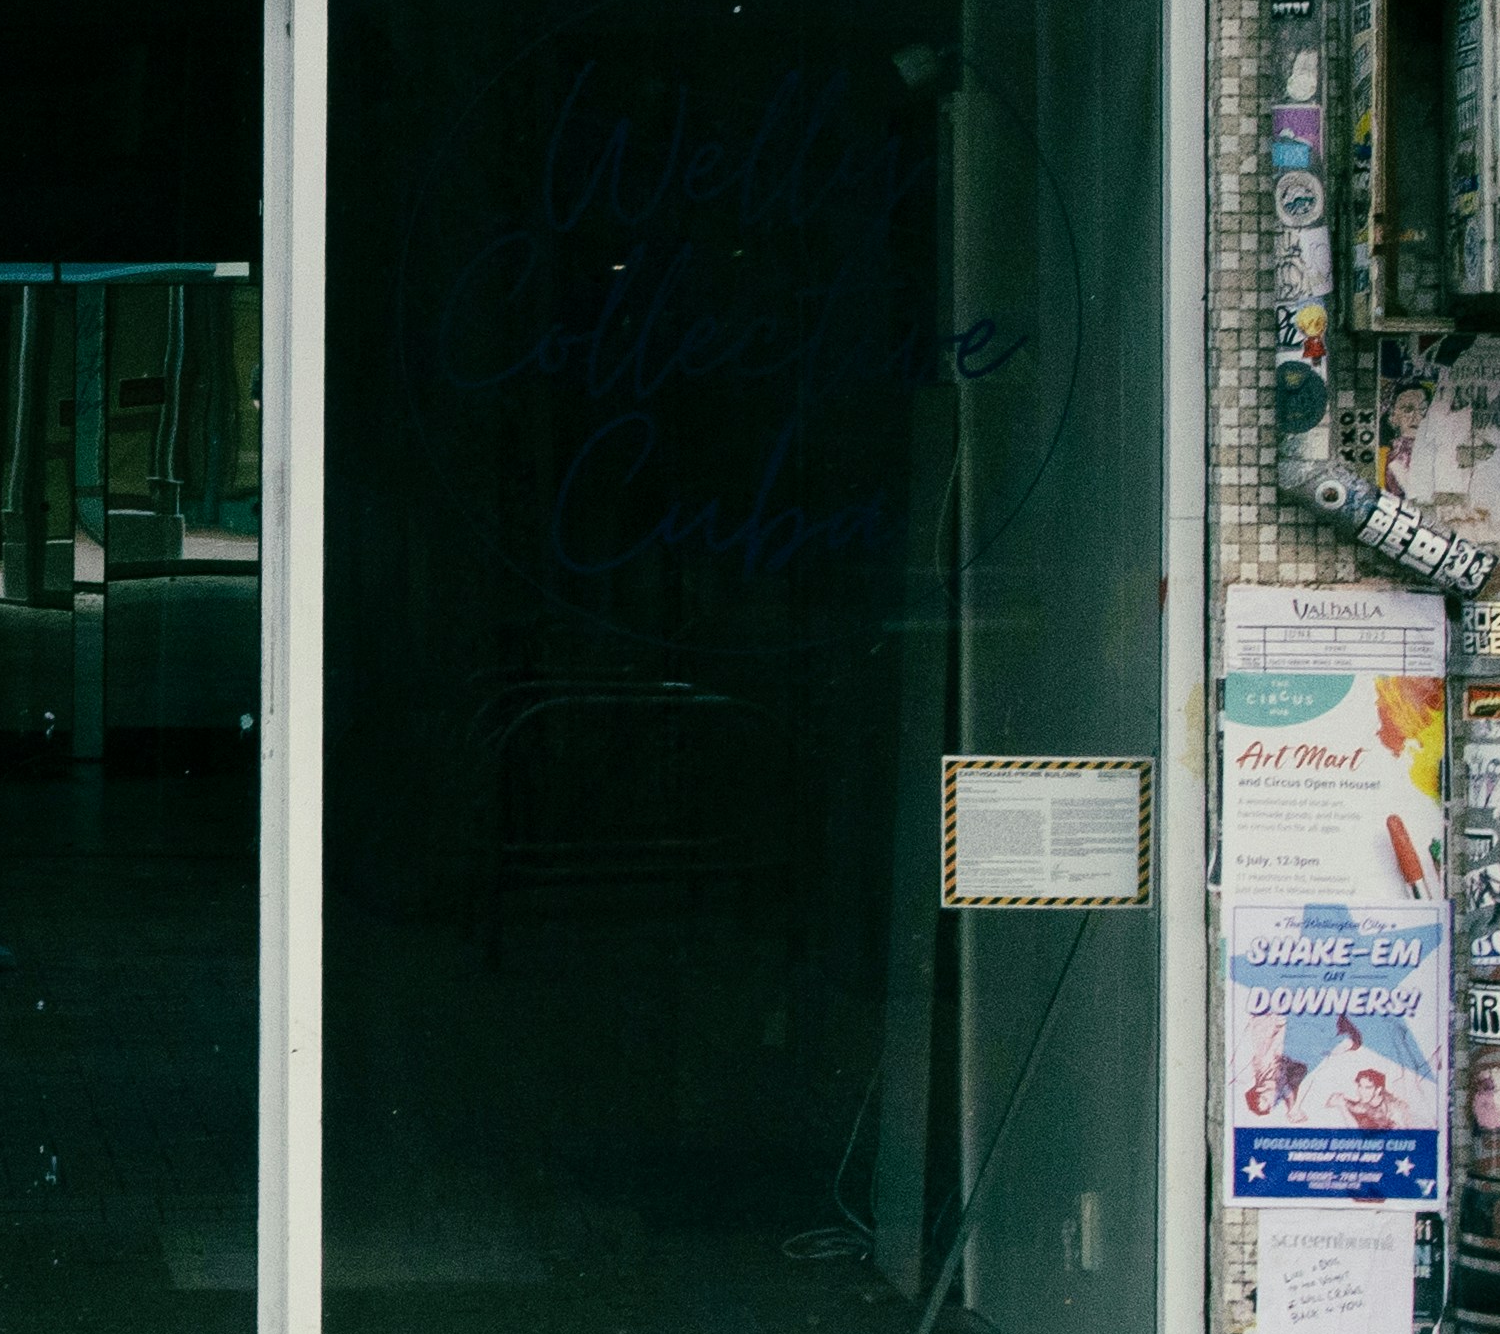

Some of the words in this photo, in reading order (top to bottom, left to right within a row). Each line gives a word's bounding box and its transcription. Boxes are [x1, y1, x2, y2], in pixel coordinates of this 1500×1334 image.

[1246, 690, 1314, 706] CIRCUS
[1236, 740, 1293, 771] Art
[1293, 743, 1371, 772] Mart
[1238, 777, 1261, 788] and
[1263, 777, 1301, 788] Circus
[1303, 778, 1336, 791] Open
[1339, 779, 1381, 790] House!
[1246, 936, 1423, 969] SHAKE-EM
[1246, 985, 1422, 1018] DOWNERS!
